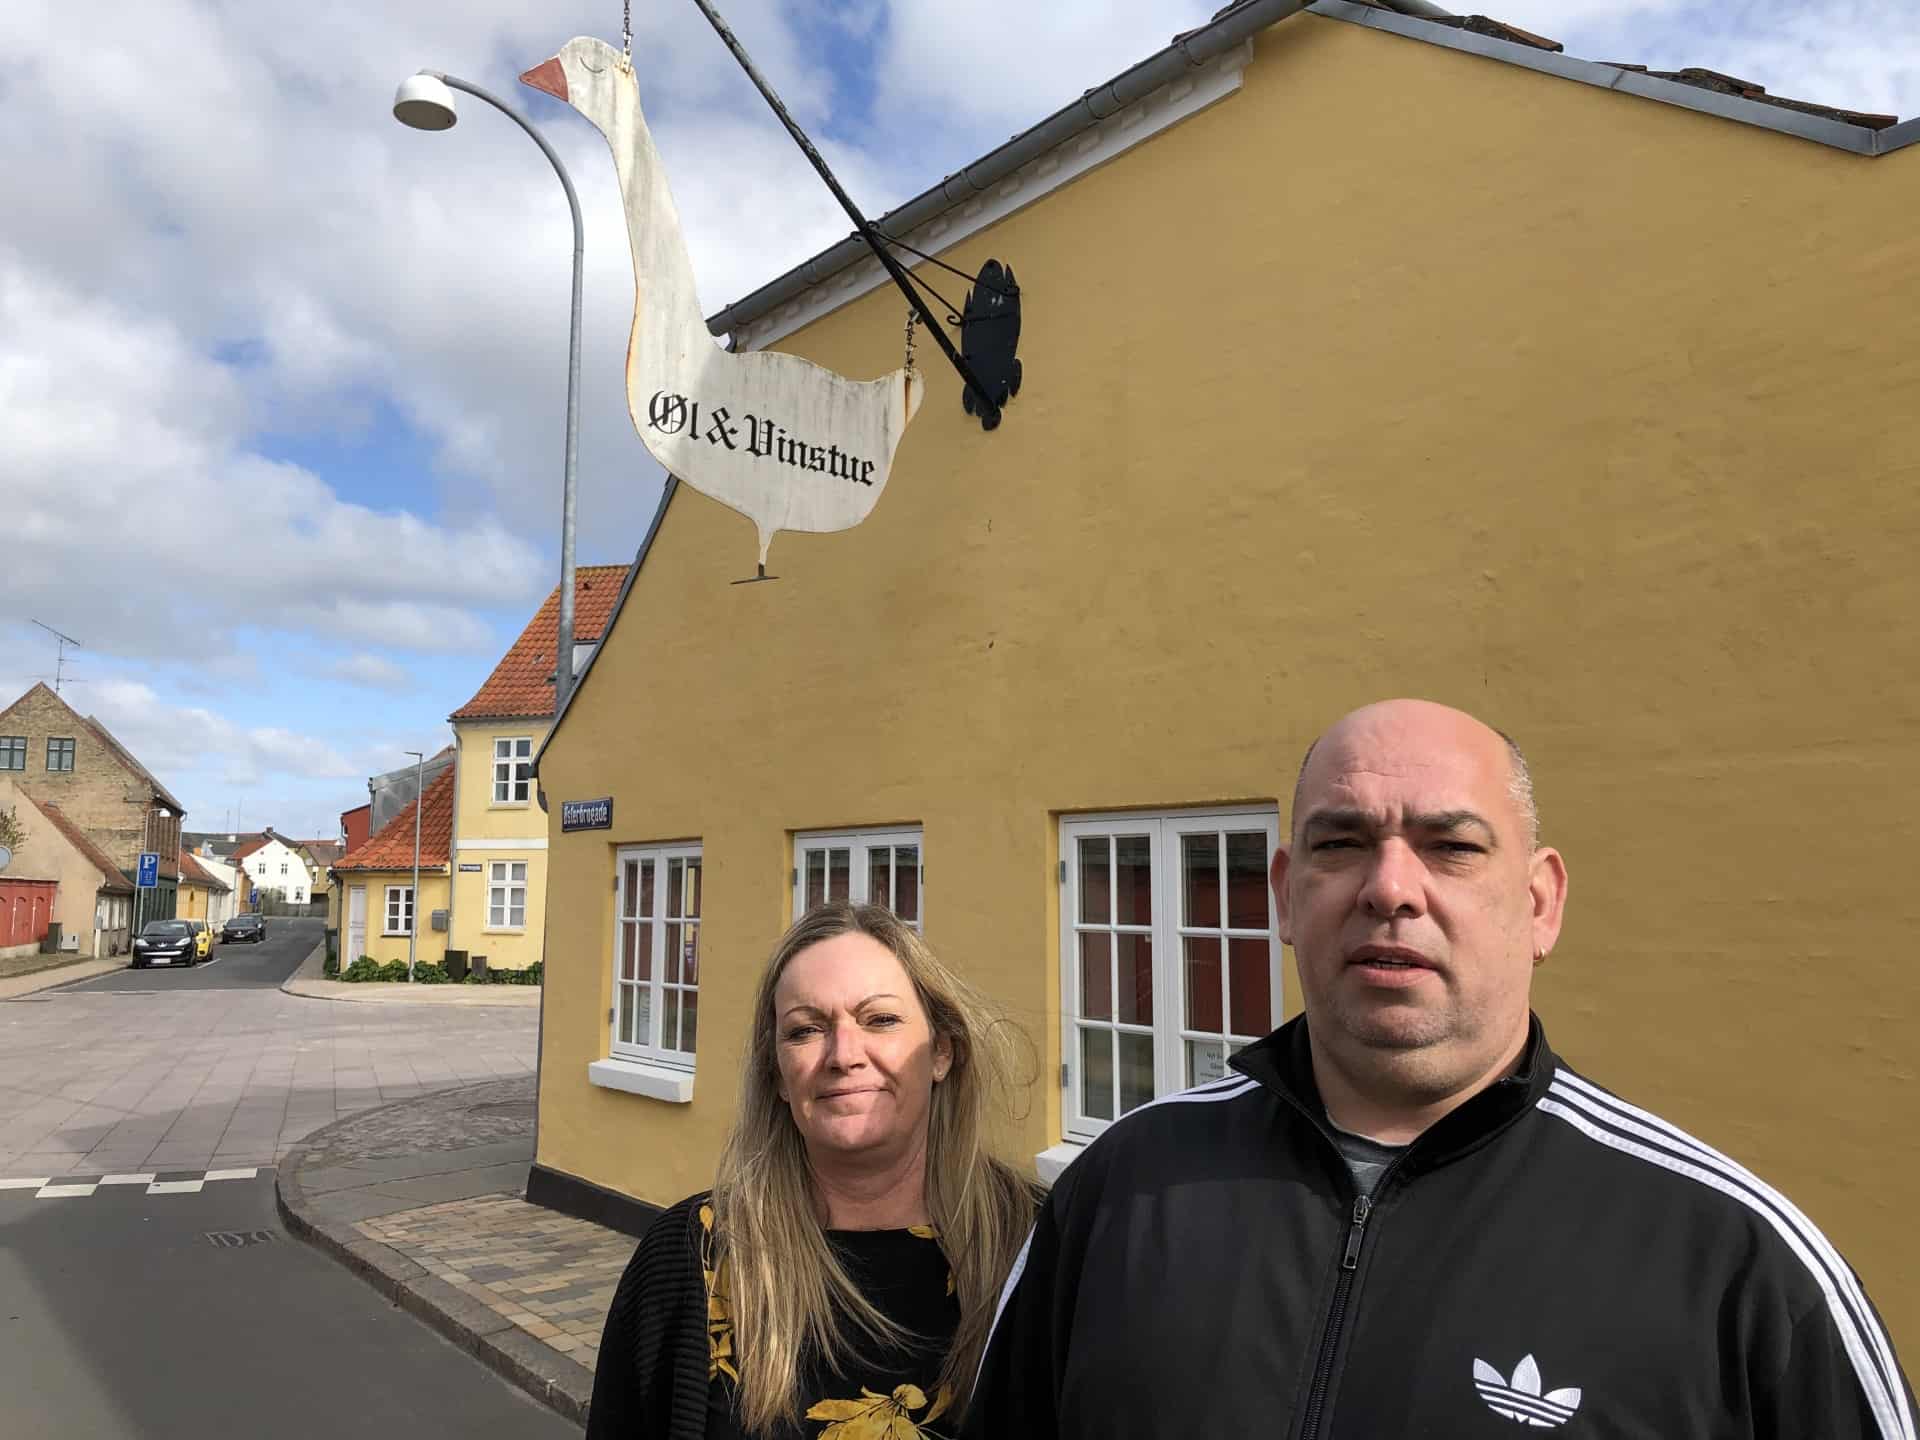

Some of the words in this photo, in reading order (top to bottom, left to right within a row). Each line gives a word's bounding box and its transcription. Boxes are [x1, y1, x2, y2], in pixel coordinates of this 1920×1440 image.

[648, 390, 700, 440] Øl
[744, 415, 875, 487] Vinstue
[143, 856, 156, 869] P
